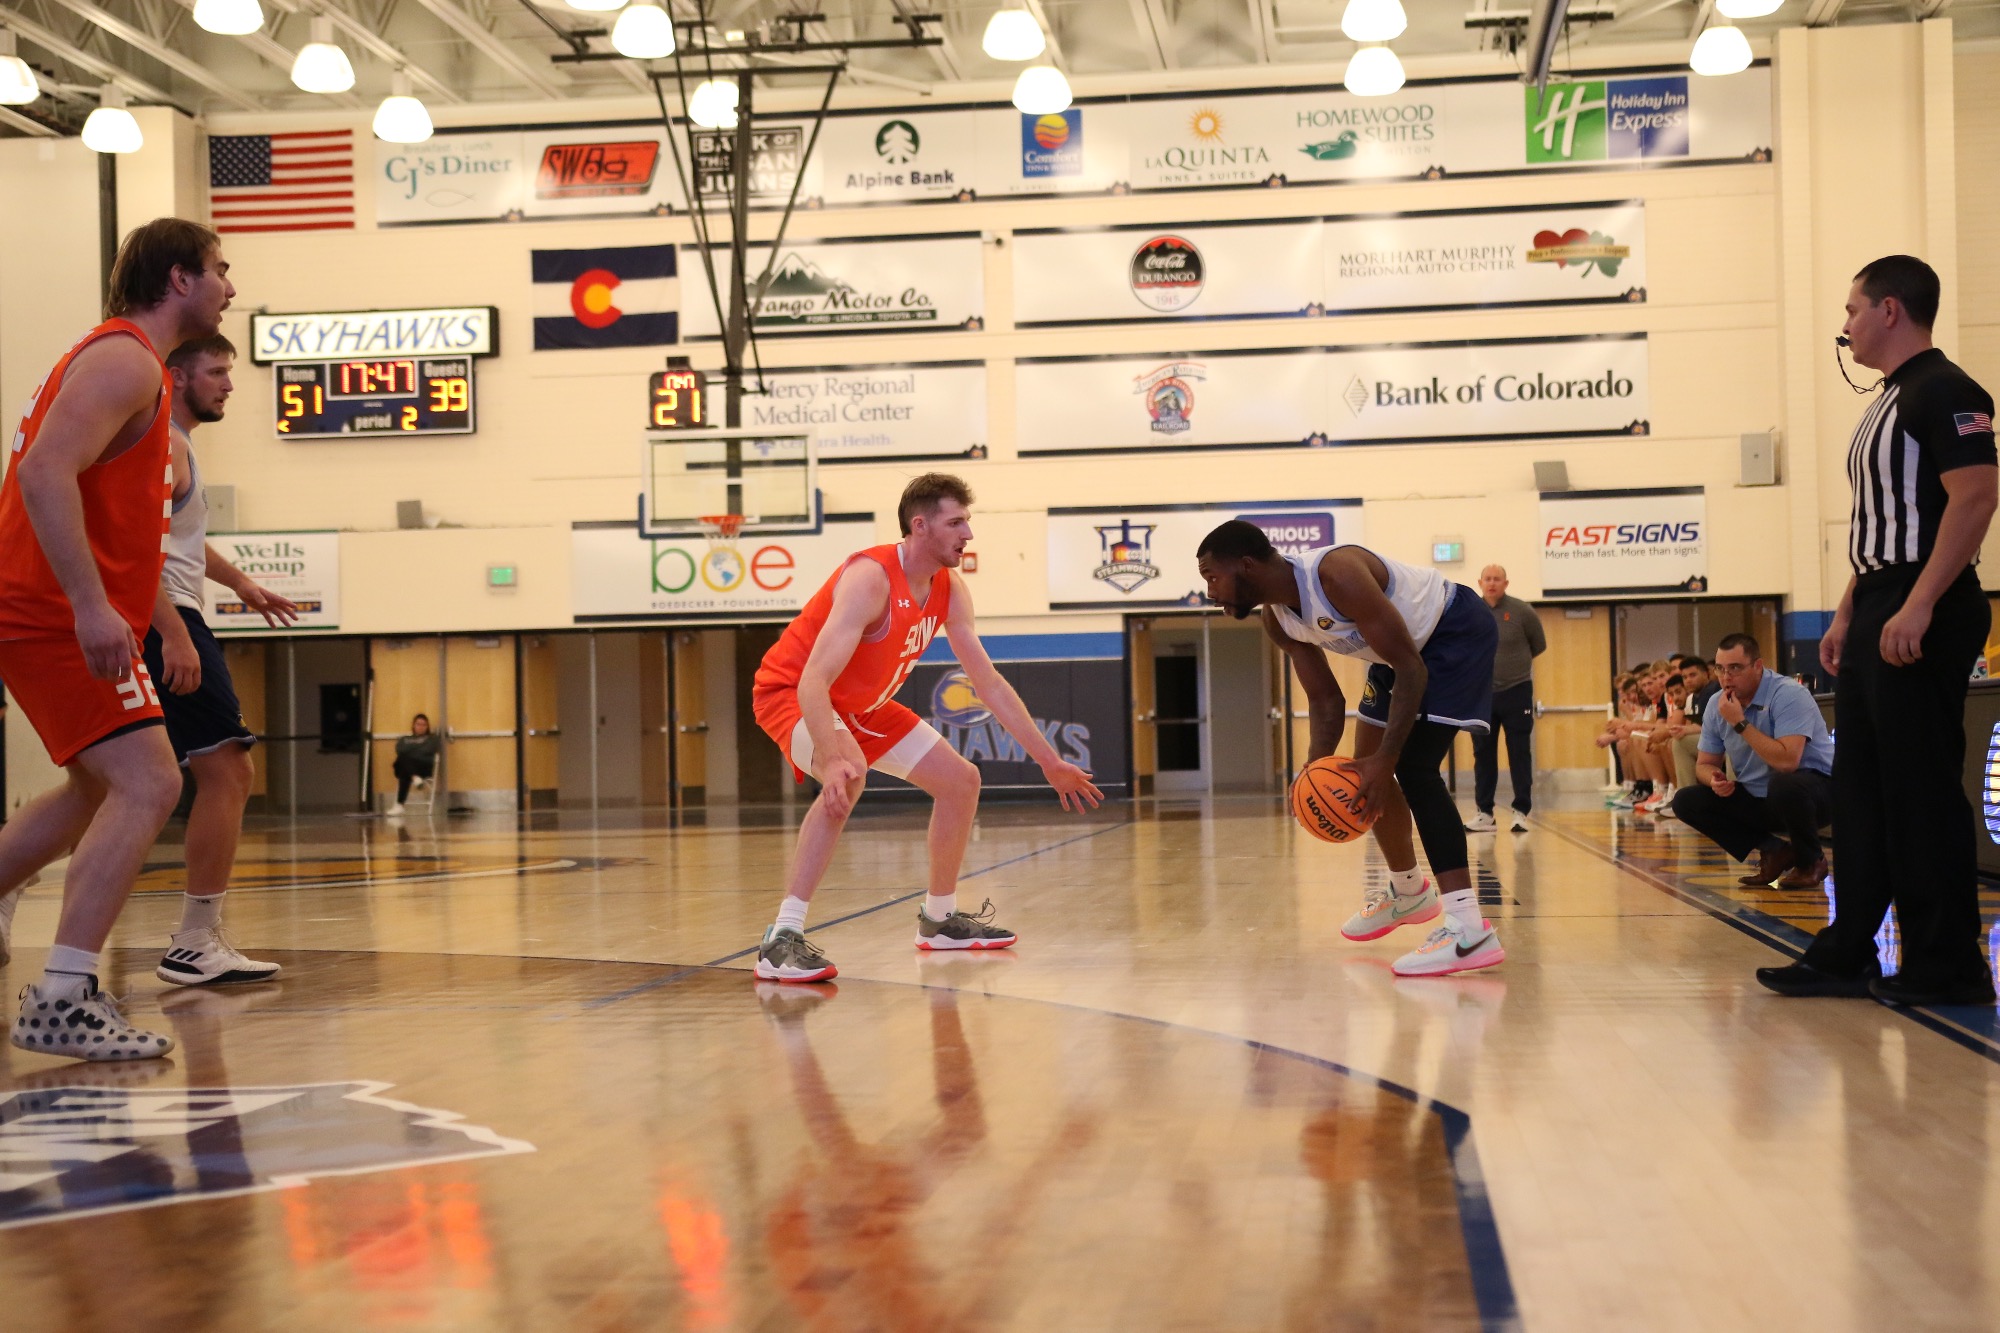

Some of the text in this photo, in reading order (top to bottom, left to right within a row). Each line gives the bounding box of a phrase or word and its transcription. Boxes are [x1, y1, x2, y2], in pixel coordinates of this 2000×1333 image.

[1611, 91, 1686, 111] Holiday Inn
[1297, 104, 1434, 128] HOMEWOOD
[1611, 110, 1684, 134] Express
[699, 134, 768, 153] BAK
[1364, 124, 1435, 142] SUITES
[1165, 146, 1271, 172] QUINTA
[384, 155, 512, 200] CJ's Diner
[846, 168, 954, 190] Alpine Bank
[1210, 170, 1256, 180] SUITES
[1441, 245, 1516, 262] MURPHY
[1138, 271, 1196, 283] DURANGO
[1340, 260, 1516, 279] REGIONAL AUTO CENTER
[757, 287, 933, 318] ango Motor Co.
[261, 315, 482, 355] SKYHAWKS
[283, 367, 316, 383] Home
[341, 361, 415, 394] 17:47
[428, 378, 468, 412] 39
[824, 374, 916, 403] Regional
[1374, 369, 1634, 408] Bank of Colorado
[282, 384, 324, 417] 51
[655, 388, 701, 426] 21
[355, 413, 393, 431] period
[401, 406, 418, 431] 2
[753, 402, 914, 426] Medical Center
[233, 542, 305, 559] Wells
[1545, 550, 1570, 560] More
[1573, 549, 1594, 559] than
[1597, 547, 1618, 559] fast.
[1621, 547, 1646, 557] More
[1649, 545, 1671, 556] than
[233, 560, 305, 577] Group
[1096, 564, 1158, 580] STEAMWORKS
[651, 598, 798, 610] BOEDECKER FOUNDATION
[1306, 795, 1349, 840] Wilson
